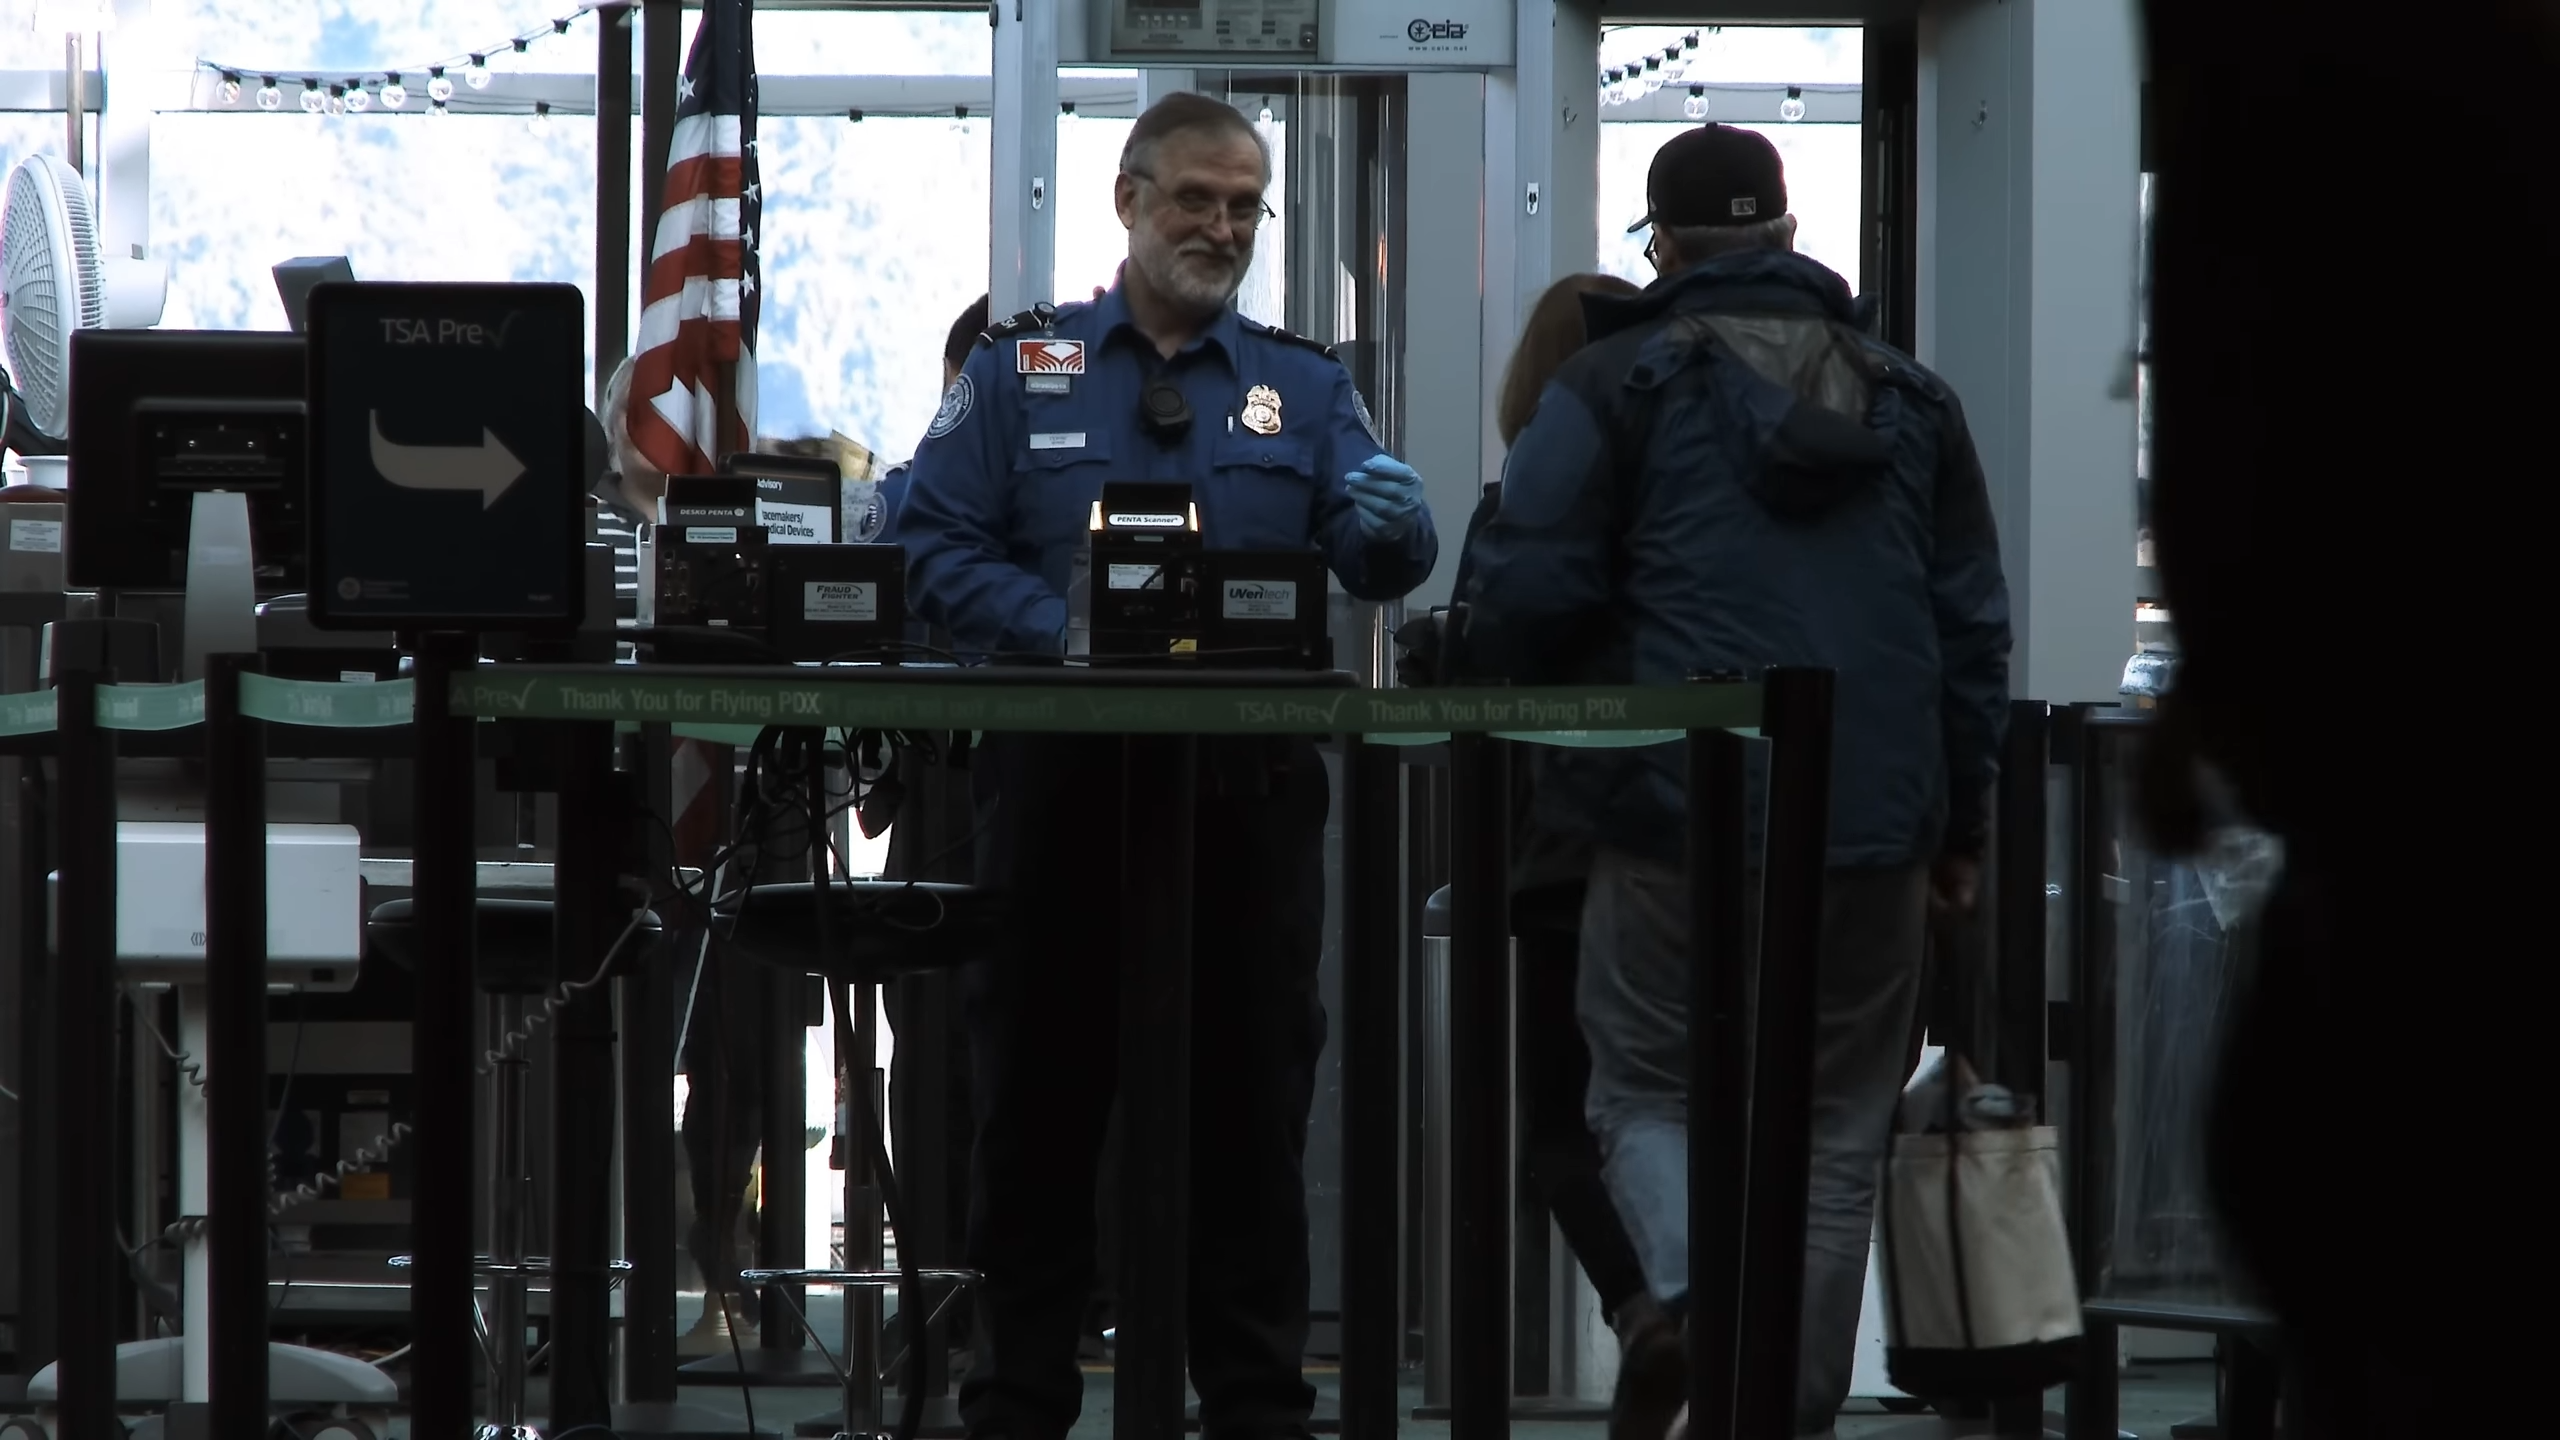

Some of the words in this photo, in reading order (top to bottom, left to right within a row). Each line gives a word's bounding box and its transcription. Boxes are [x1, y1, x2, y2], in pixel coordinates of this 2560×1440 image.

[379, 318, 431, 344] TSA
[438, 318, 483, 345] Pre
[757, 478, 782, 491] Advisory
[680, 508, 707, 516] DESKO
[762, 510, 804, 524] acemakers/
[764, 523, 786, 536] edical
[787, 524, 814, 538] Devices
[817, 585, 851, 594] FRAUD
[1229, 588, 1290, 600] UVeritech
[473, 686, 509, 708] Pre
[559, 687, 625, 711] Thank
[630, 687, 668, 712] You
[674, 688, 703, 713] for
[710, 688, 771, 718] Flying
[778, 691, 821, 715] PDX
[1235, 702, 1277, 724] TSA
[1283, 702, 1321, 724] Pre
[1368, 699, 1432, 723] Thank
[1439, 699, 1476, 723] You
[1483, 697, 1511, 722] for
[1517, 697, 1579, 726] Flying
[1586, 697, 1628, 721] PDX
